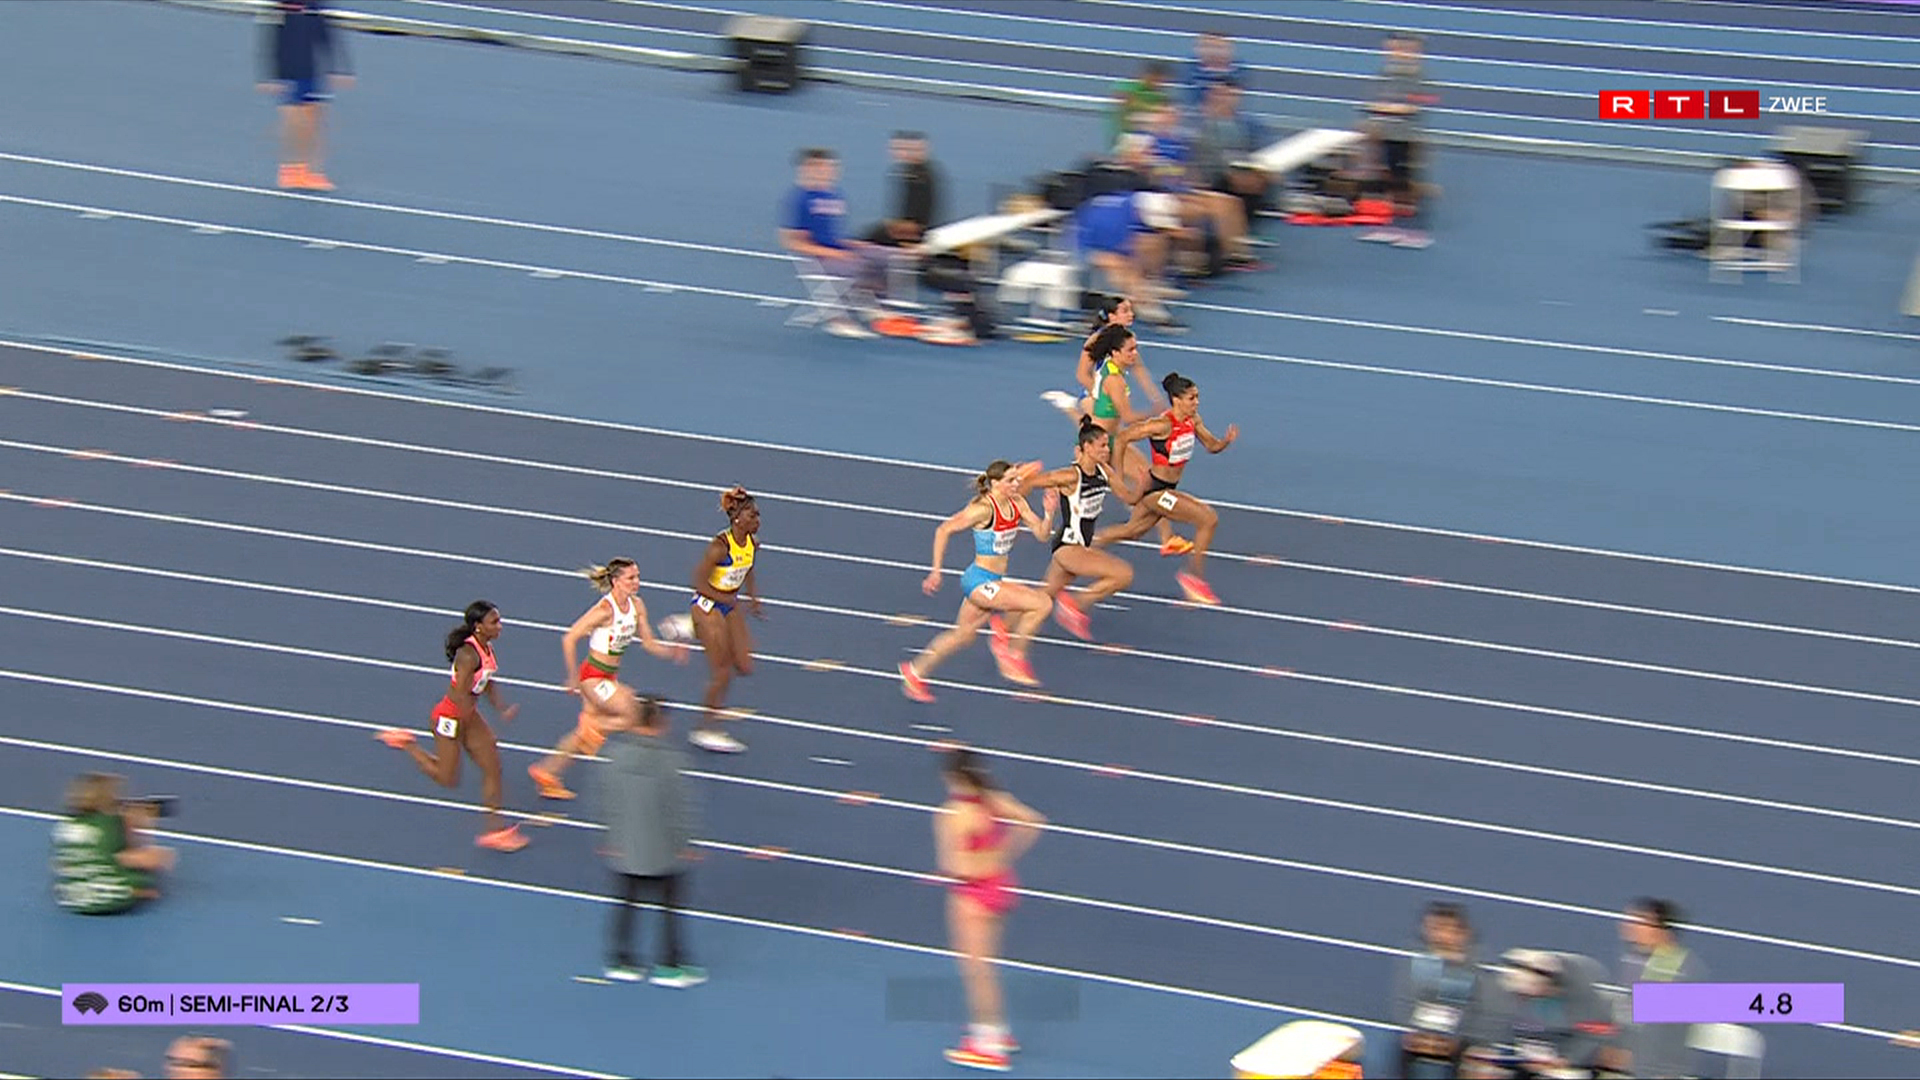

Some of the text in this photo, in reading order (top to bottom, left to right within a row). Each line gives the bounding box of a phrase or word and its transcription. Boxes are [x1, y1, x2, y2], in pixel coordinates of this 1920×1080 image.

[1161, 496, 1173, 507] 3
[1067, 531, 1076, 541] 4
[983, 584, 996, 595] 5
[599, 682, 609, 696] 7
